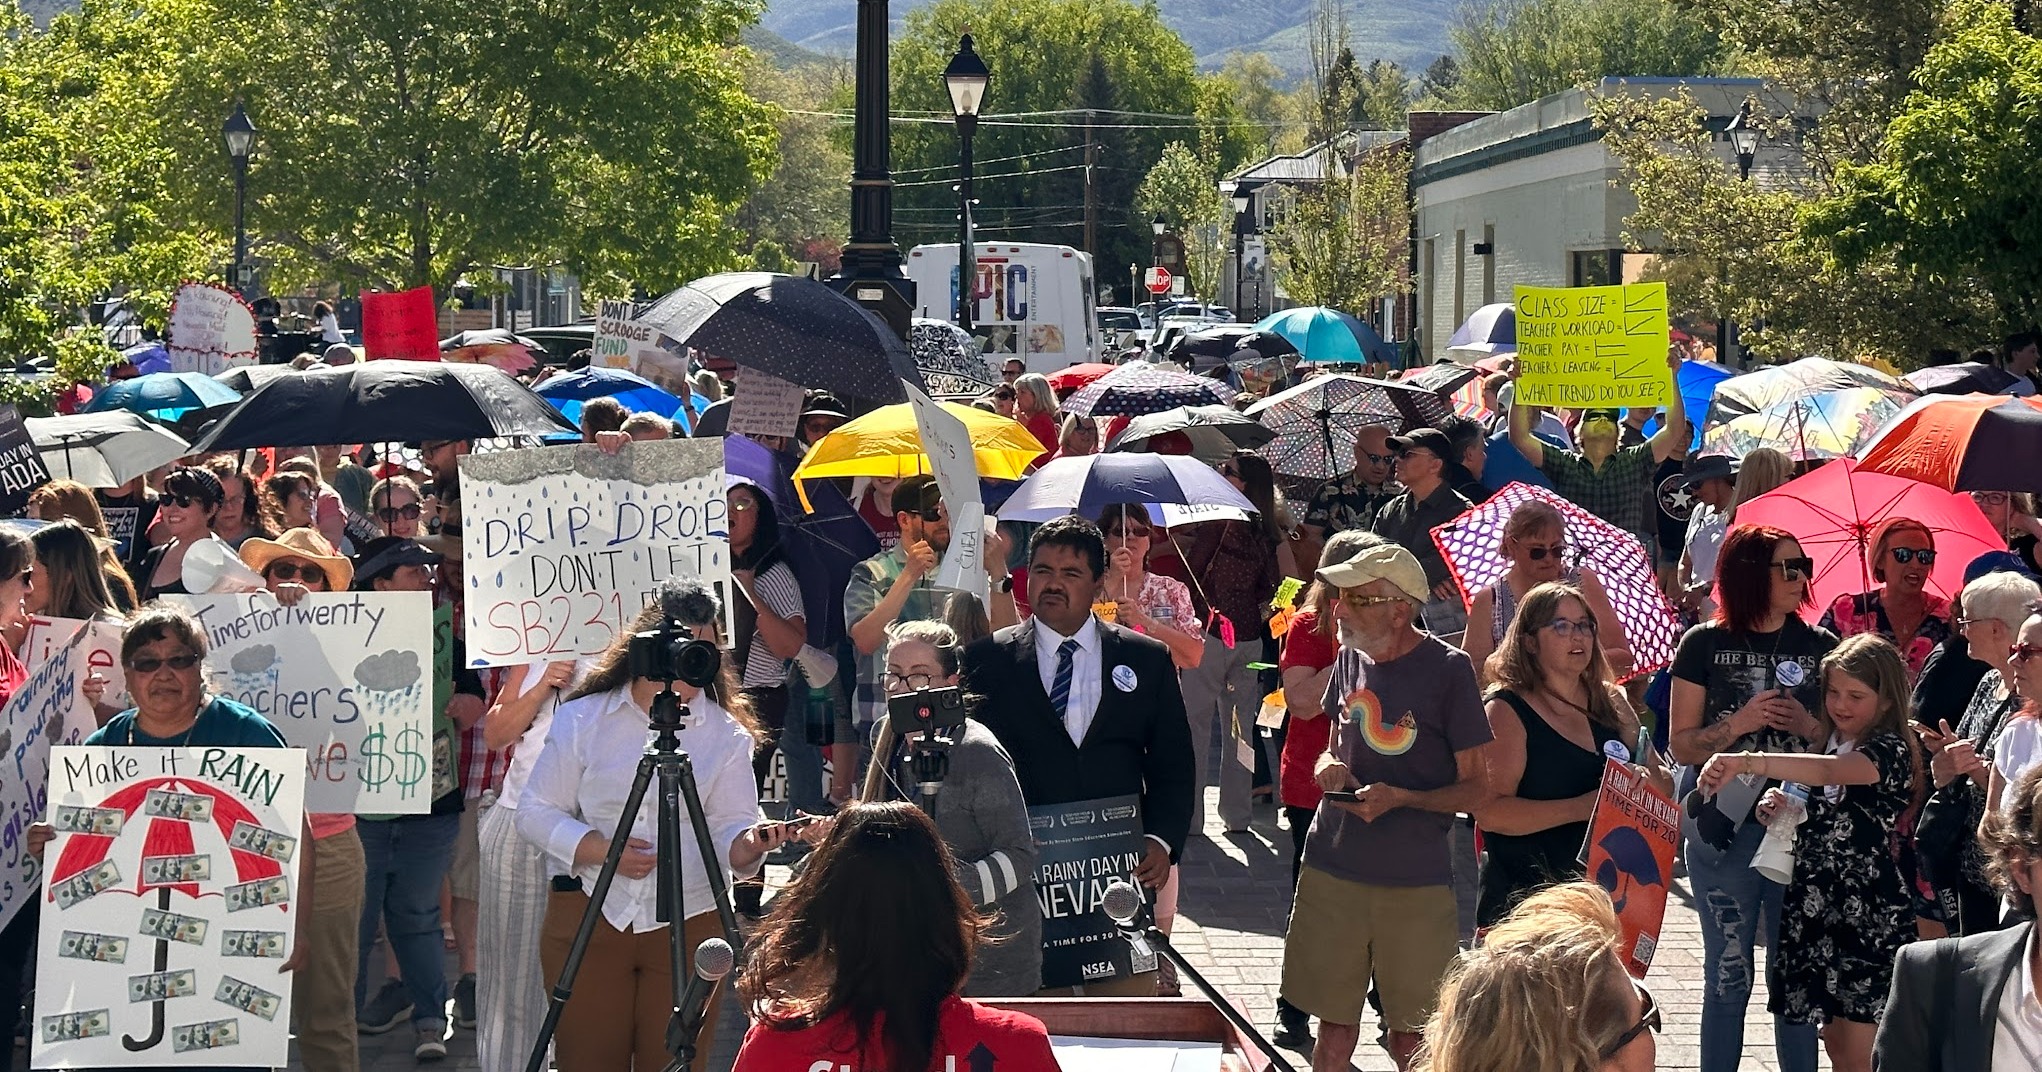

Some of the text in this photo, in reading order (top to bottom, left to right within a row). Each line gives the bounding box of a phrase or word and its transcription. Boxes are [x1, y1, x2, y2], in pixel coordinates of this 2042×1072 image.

[600, 299, 630, 320] DONT
[1519, 295, 1569, 318] CLASS
[1576, 295, 1607, 316] SIZE
[600, 320, 652, 341] SCROOGE
[1518, 321, 1557, 338] TEACHER
[1561, 320, 1615, 336] WORKLOAD
[595, 336, 628, 356] FUND
[1518, 341, 1553, 357] TEACHER
[1562, 342, 1579, 356] PAY
[1519, 358, 1558, 375] TEACHERS
[1563, 360, 1601, 374] LEAVING
[1519, 383, 1554, 402] WHAT
[1558, 384, 1596, 402] TRENDS
[1600, 385, 1613, 400] DO
[1616, 384, 1634, 398] YOU
[20, 442, 34, 458] IN
[0, 457, 47, 496] ADA
[531, 543, 708, 599] DON'T LET
[481, 592, 623, 656] SB231
[1714, 652, 1741, 664] THE
[9, 645, 70, 725] raining
[14, 669, 74, 782] pouring
[357, 720, 427, 801] $$
[64, 748, 285, 806] Make it RAIN
[1608, 767, 1614, 784] A
[1644, 792, 1654, 811] IN
[1653, 797, 1679, 828] NEVADA
[1605, 787, 1676, 844] TIME FOR 20
[1030, 852, 1140, 884] A RAINY DAY IN
[1036, 872, 1146, 919] NEVAA
[1942, 887, 1958, 918] NSEA
[1043, 931, 1113, 949] A TIME FOR 20
[1081, 961, 1116, 976] NSEA
